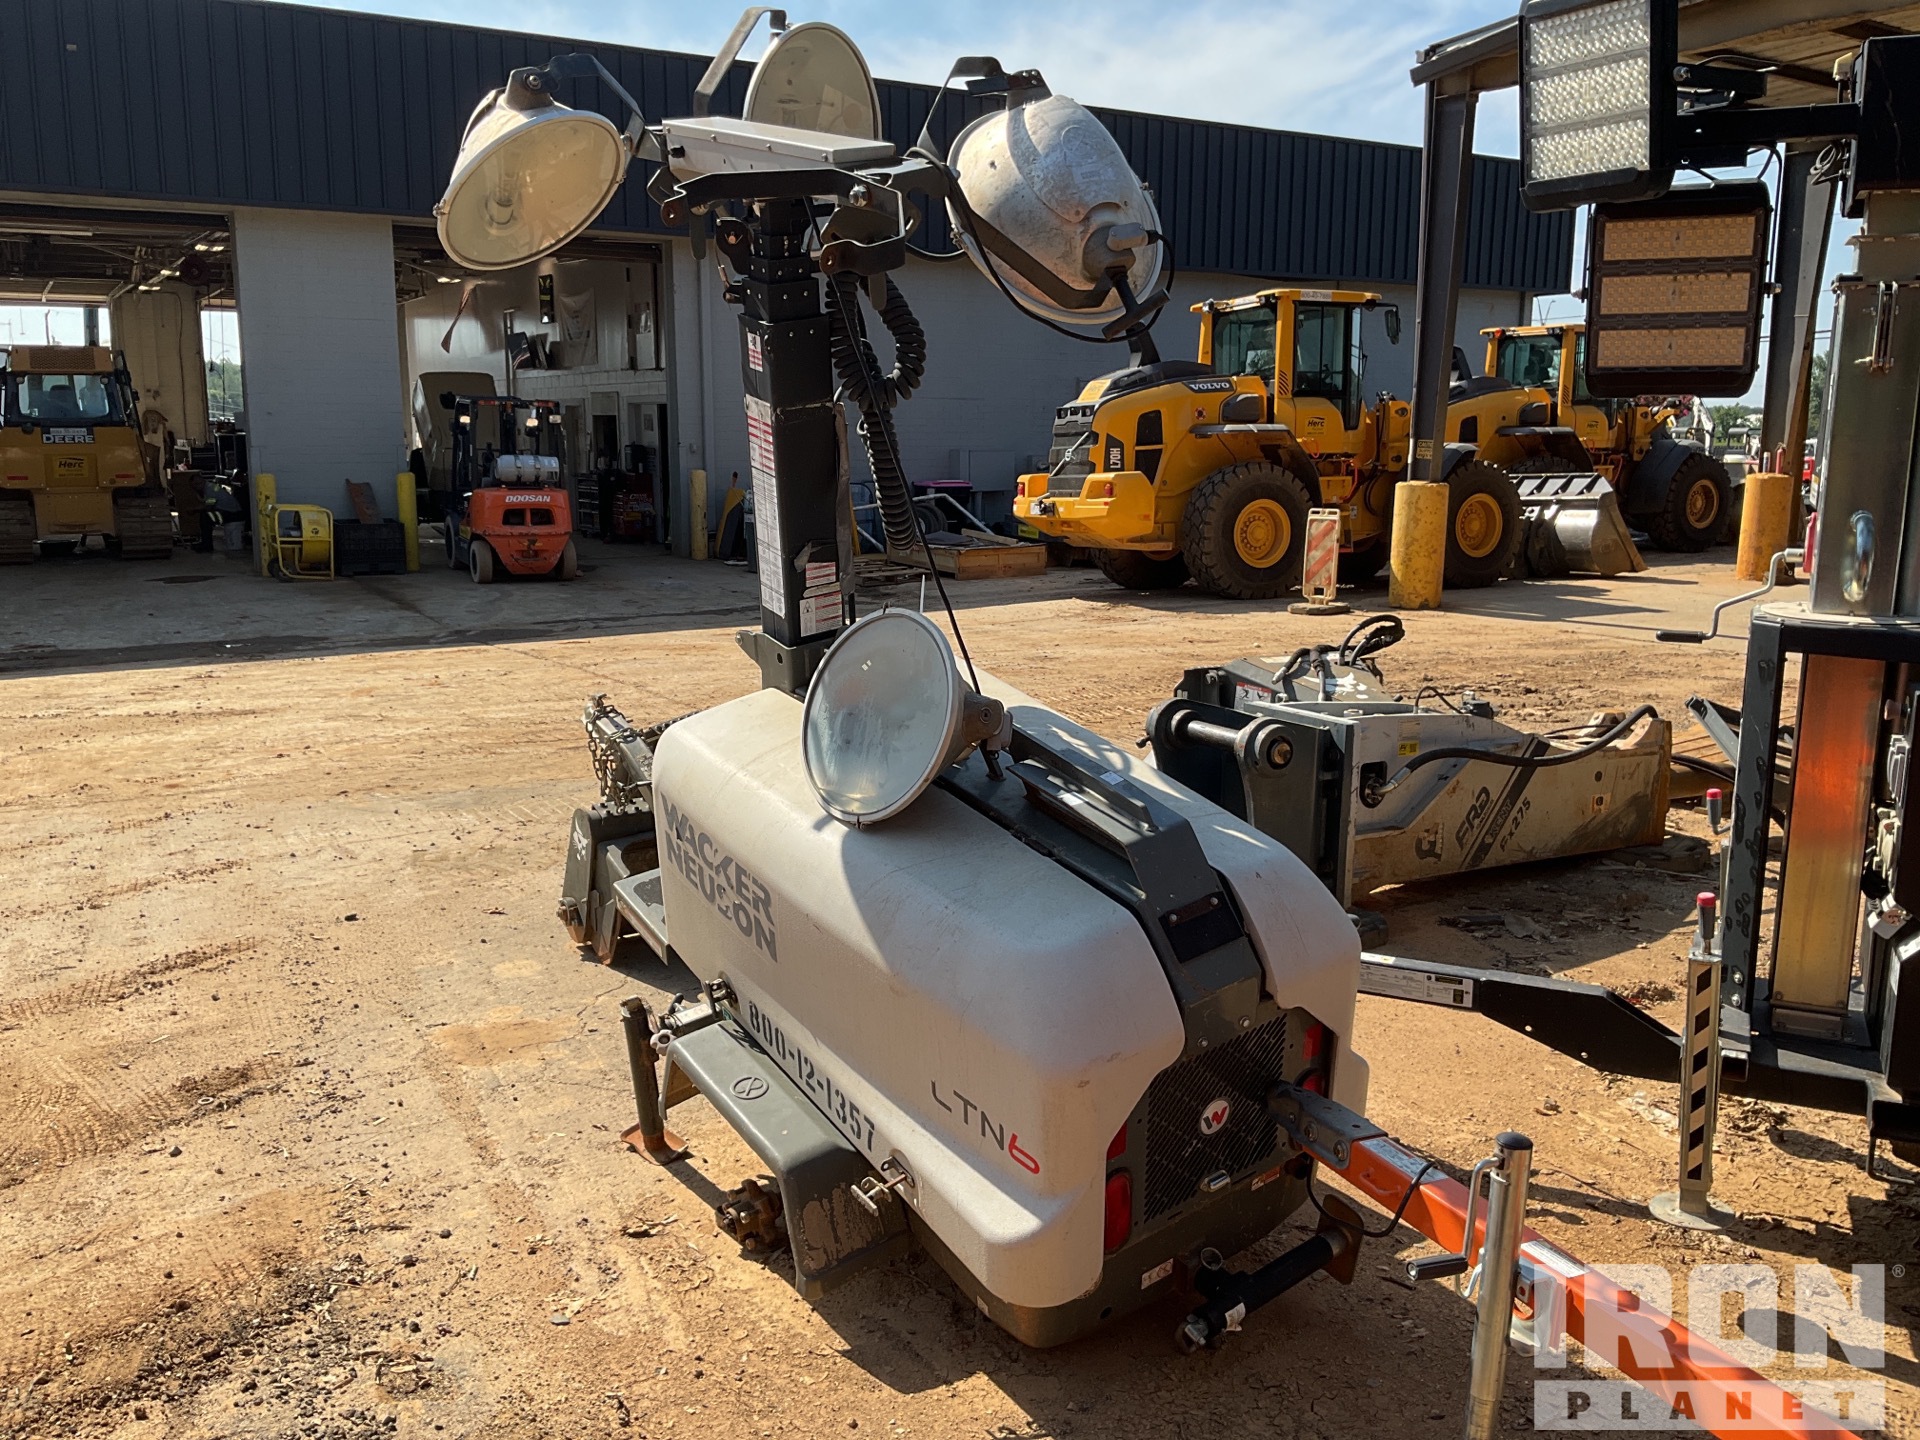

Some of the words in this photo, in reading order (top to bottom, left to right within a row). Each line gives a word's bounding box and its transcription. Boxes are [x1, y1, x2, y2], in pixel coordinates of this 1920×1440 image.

[1189, 382, 1230, 391] VOLVO
[43, 434, 95, 444] DEERE
[58, 460, 84, 469] Herc
[1109, 447, 1121, 469] L70H
[505, 495, 551, 503] DOOSAN
[660, 791, 775, 927] WACKER
[665, 830, 778, 963] NEUSON
[748, 1000, 876, 1152] 800-12-1357
[931, 1080, 1040, 1175] LTN6
